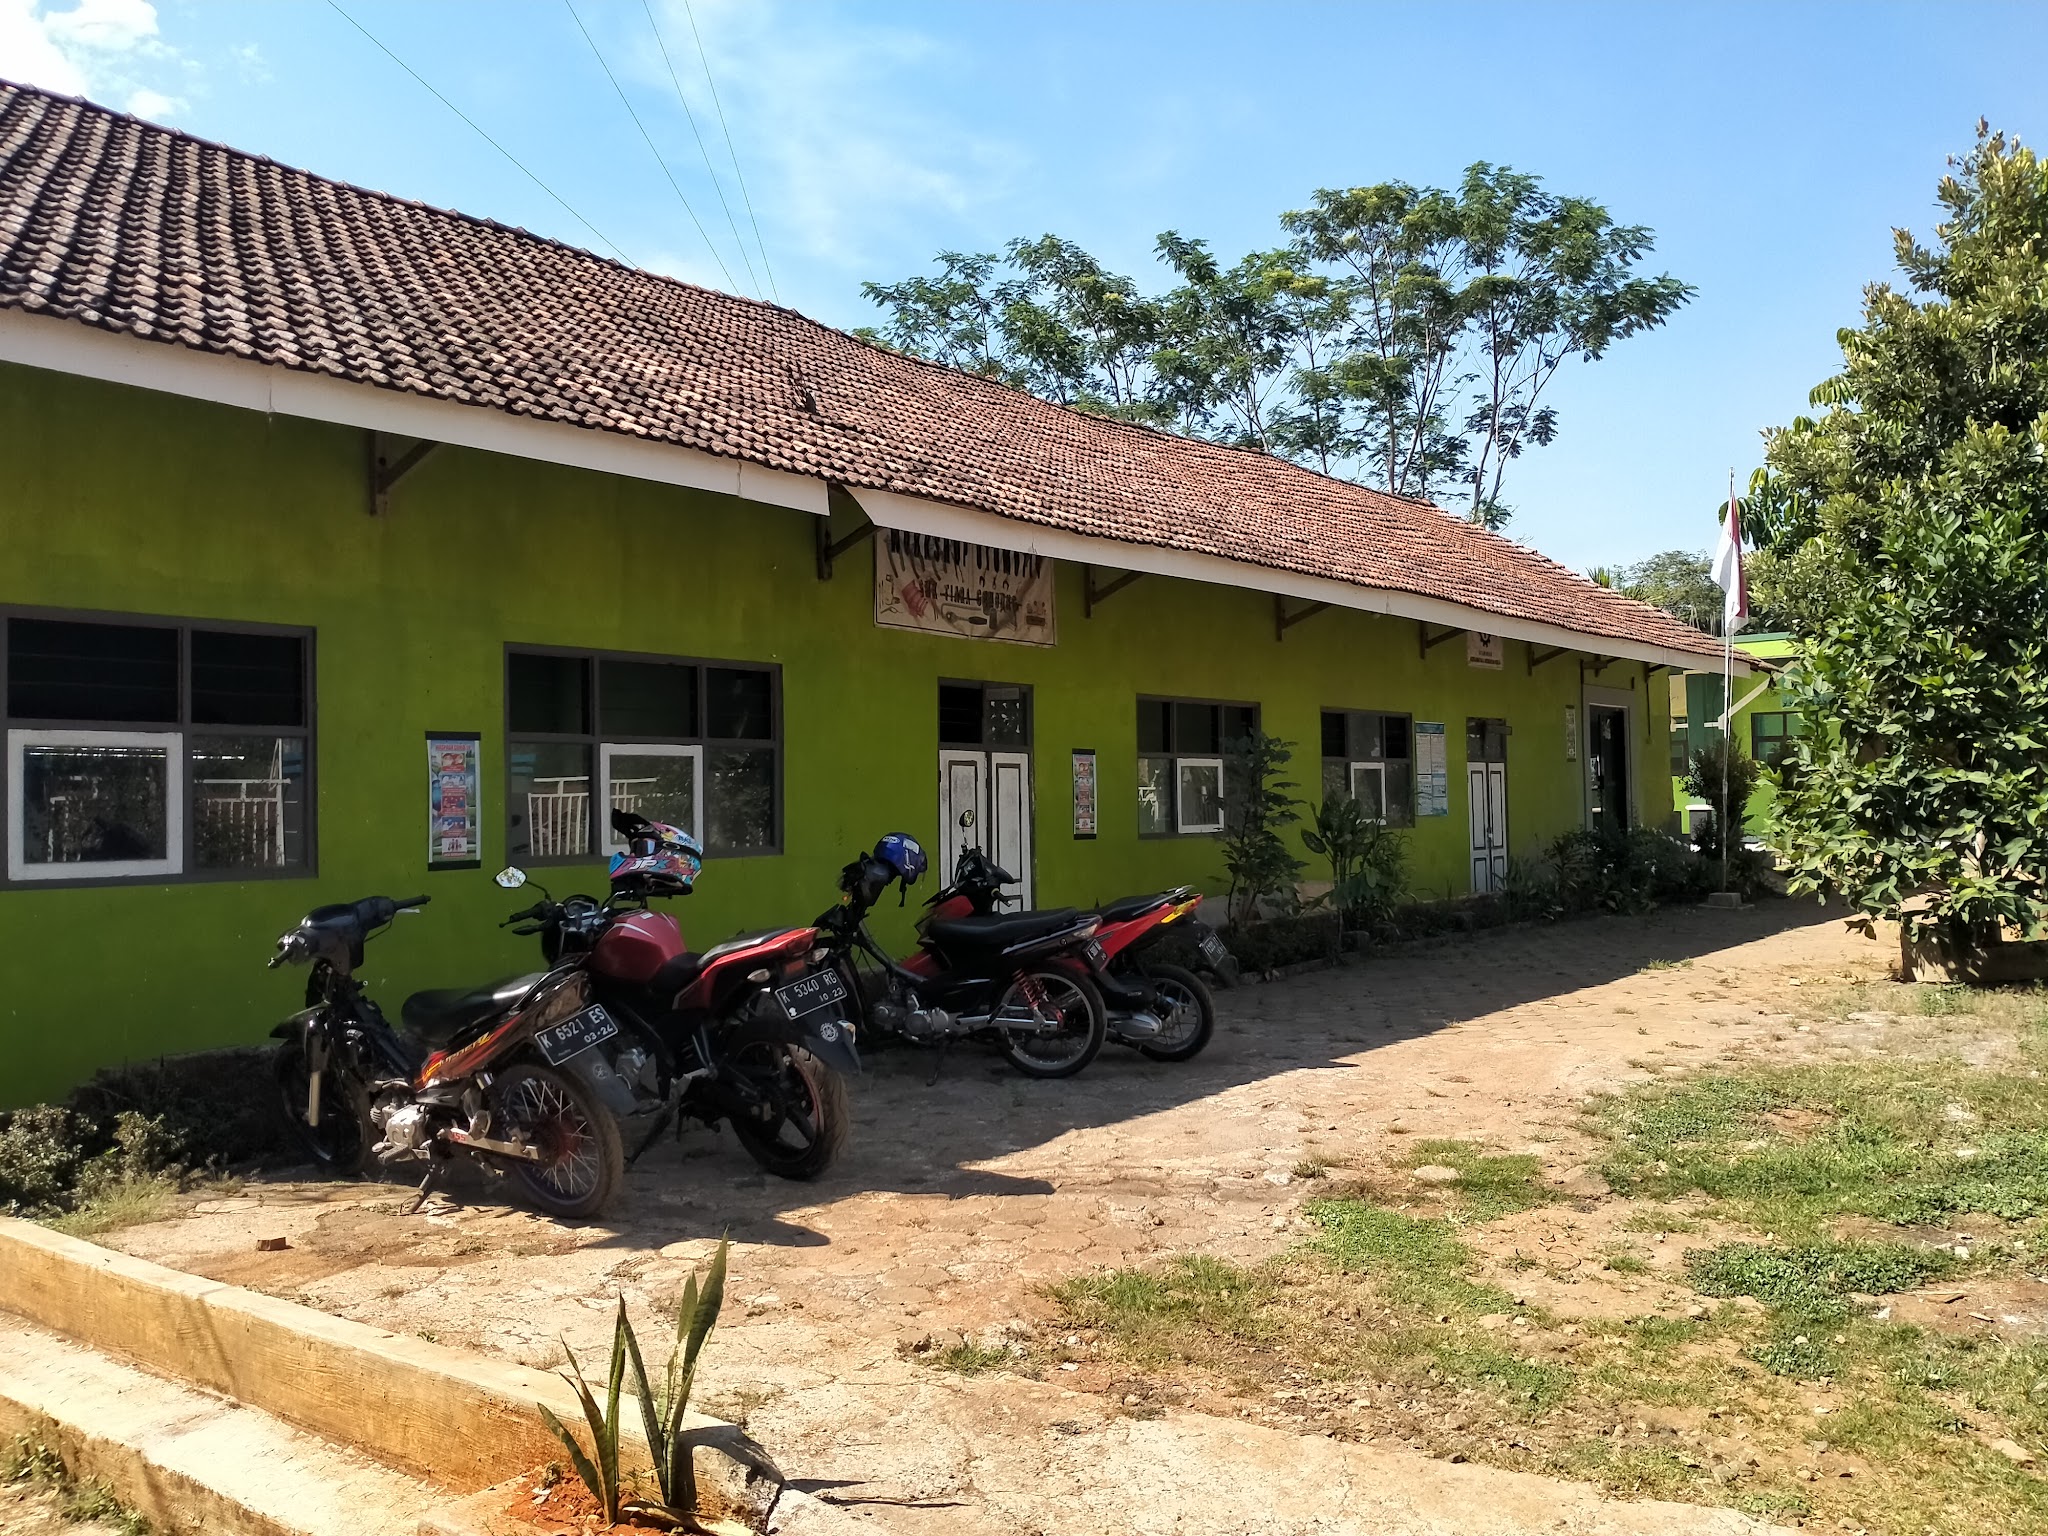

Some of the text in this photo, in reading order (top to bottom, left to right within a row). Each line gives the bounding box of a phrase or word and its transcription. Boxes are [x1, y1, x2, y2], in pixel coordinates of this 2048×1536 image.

[780, 990, 791, 1004] K
[793, 979, 820, 998] 5340
[540, 1007, 605, 1048] K 6521 ES
